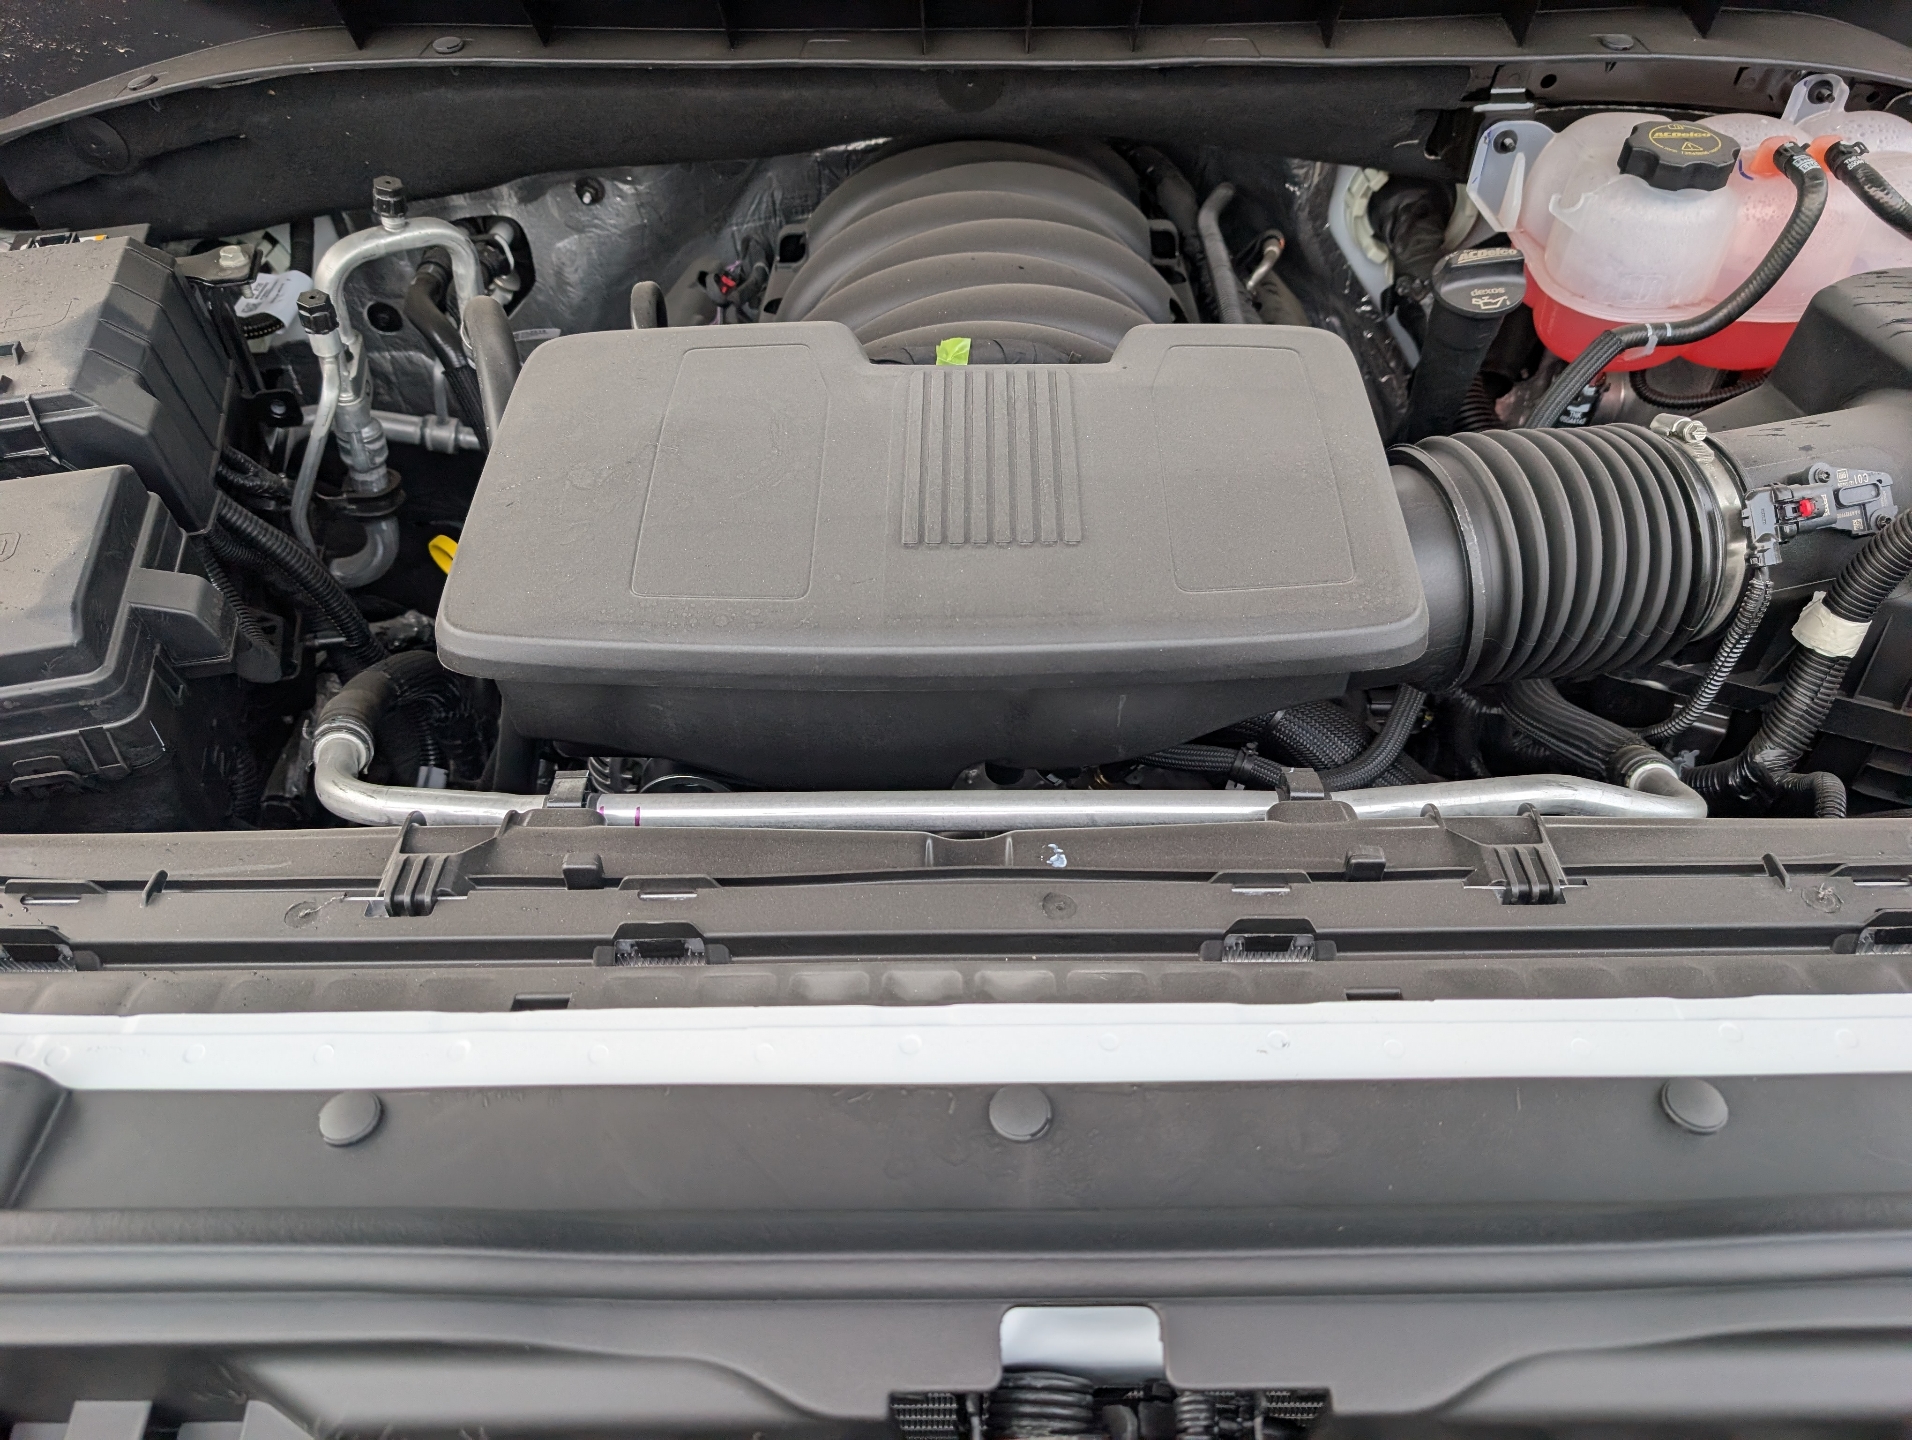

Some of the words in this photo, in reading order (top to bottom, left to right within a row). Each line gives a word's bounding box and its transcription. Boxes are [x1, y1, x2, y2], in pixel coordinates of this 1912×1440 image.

[1652, 131, 1712, 139] ACDelco
[1457, 248, 1518, 264] ACDelco
[1470, 287, 1506, 297] dexos
[1853, 472, 1870, 485] C01
